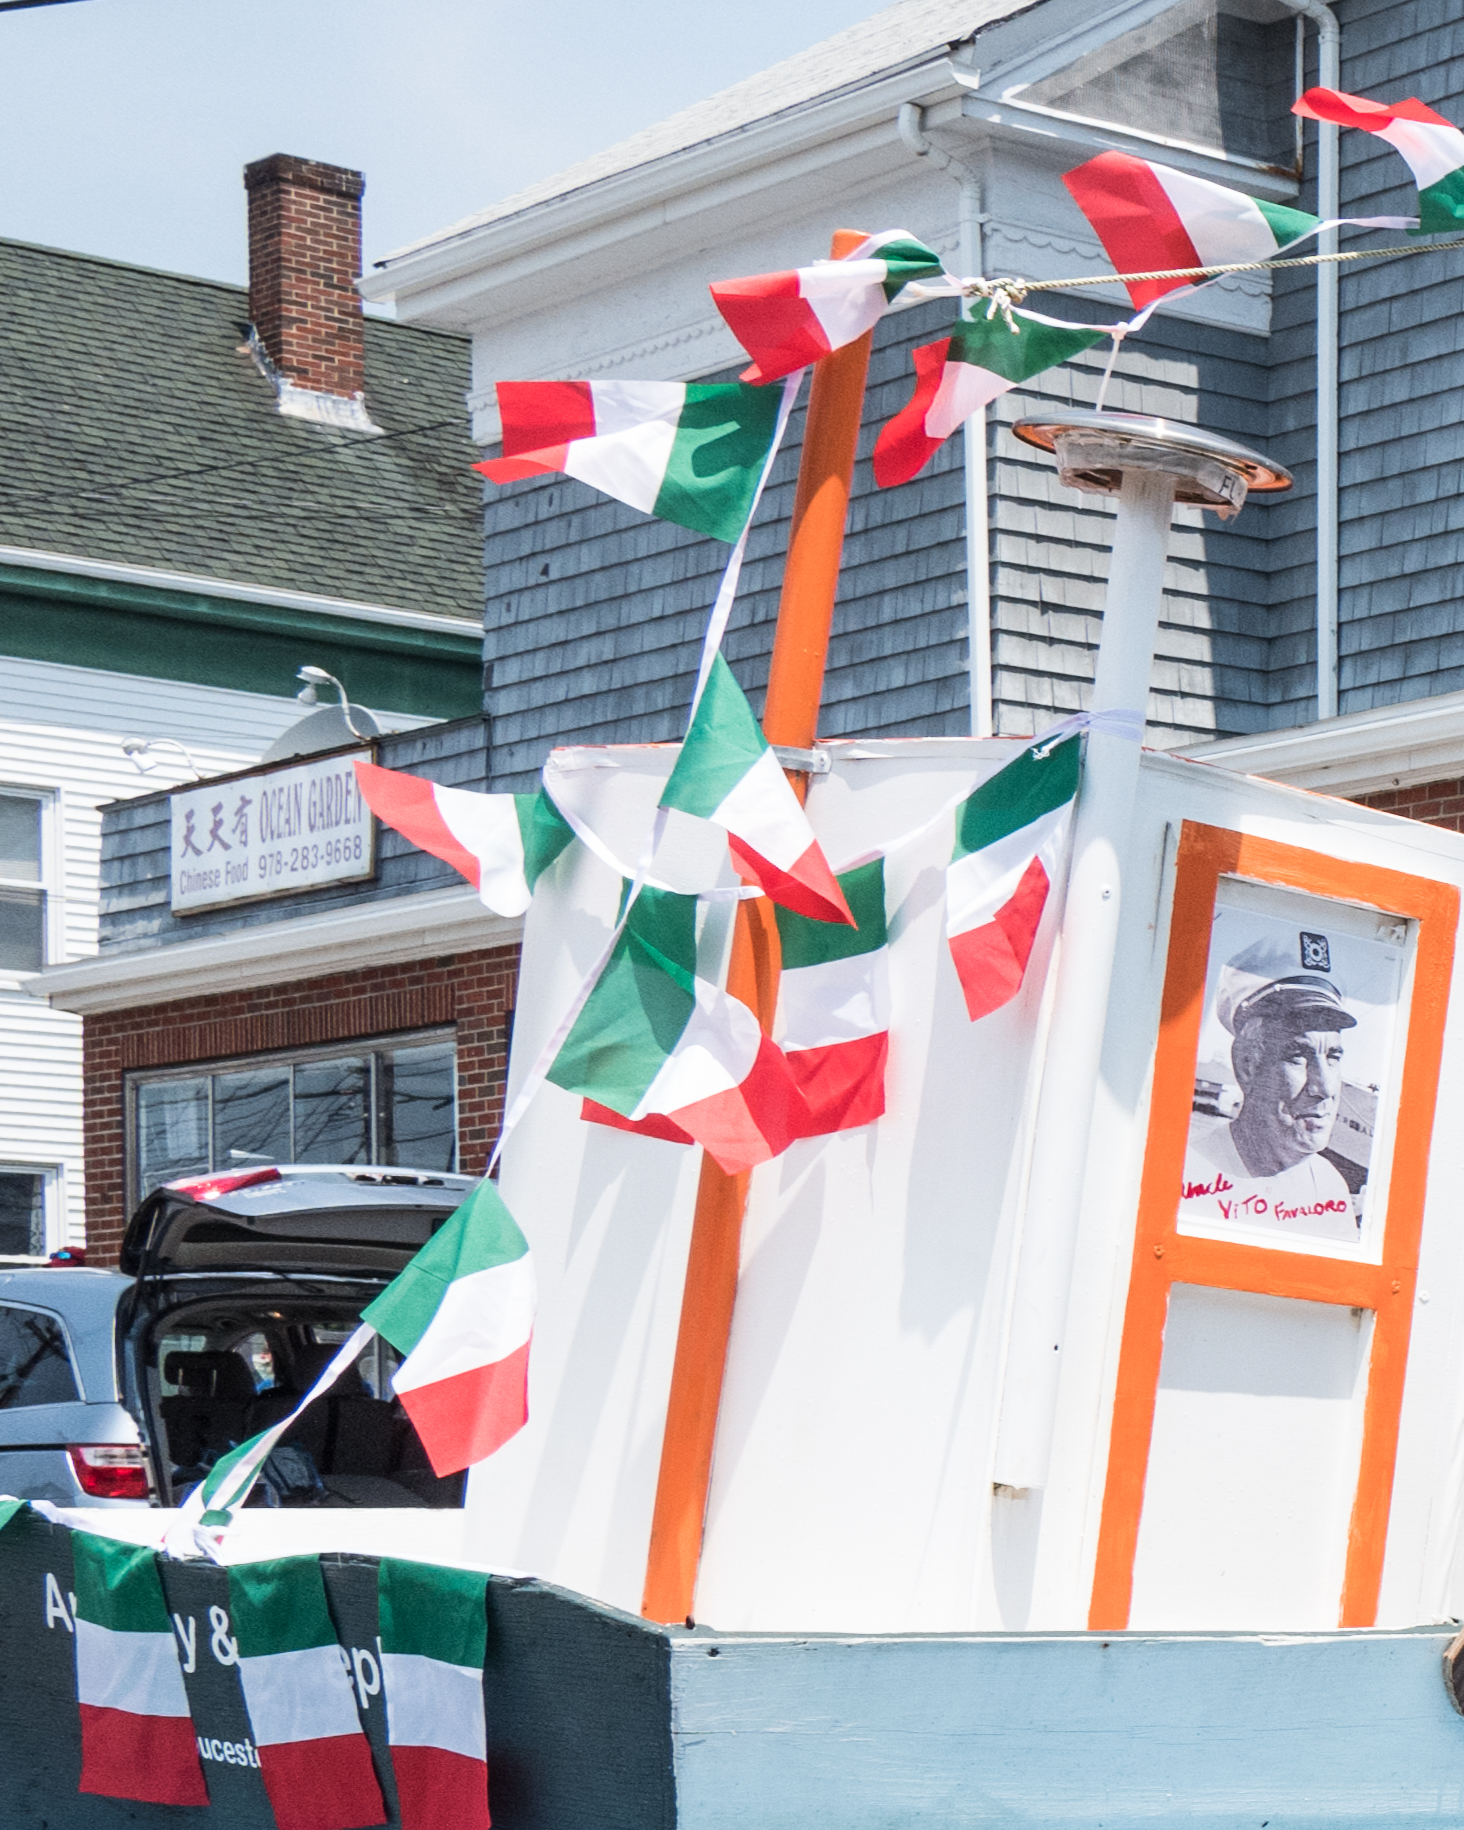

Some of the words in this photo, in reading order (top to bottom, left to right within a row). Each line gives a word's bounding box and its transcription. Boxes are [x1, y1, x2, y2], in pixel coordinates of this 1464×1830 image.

[260, 782, 303, 844] OCEAN
[308, 770, 362, 834] GARDEN
[180, 868, 221, 895] Chinese
[225, 856, 249, 885] Food
[258, 834, 362, 879] 978-283-9668
